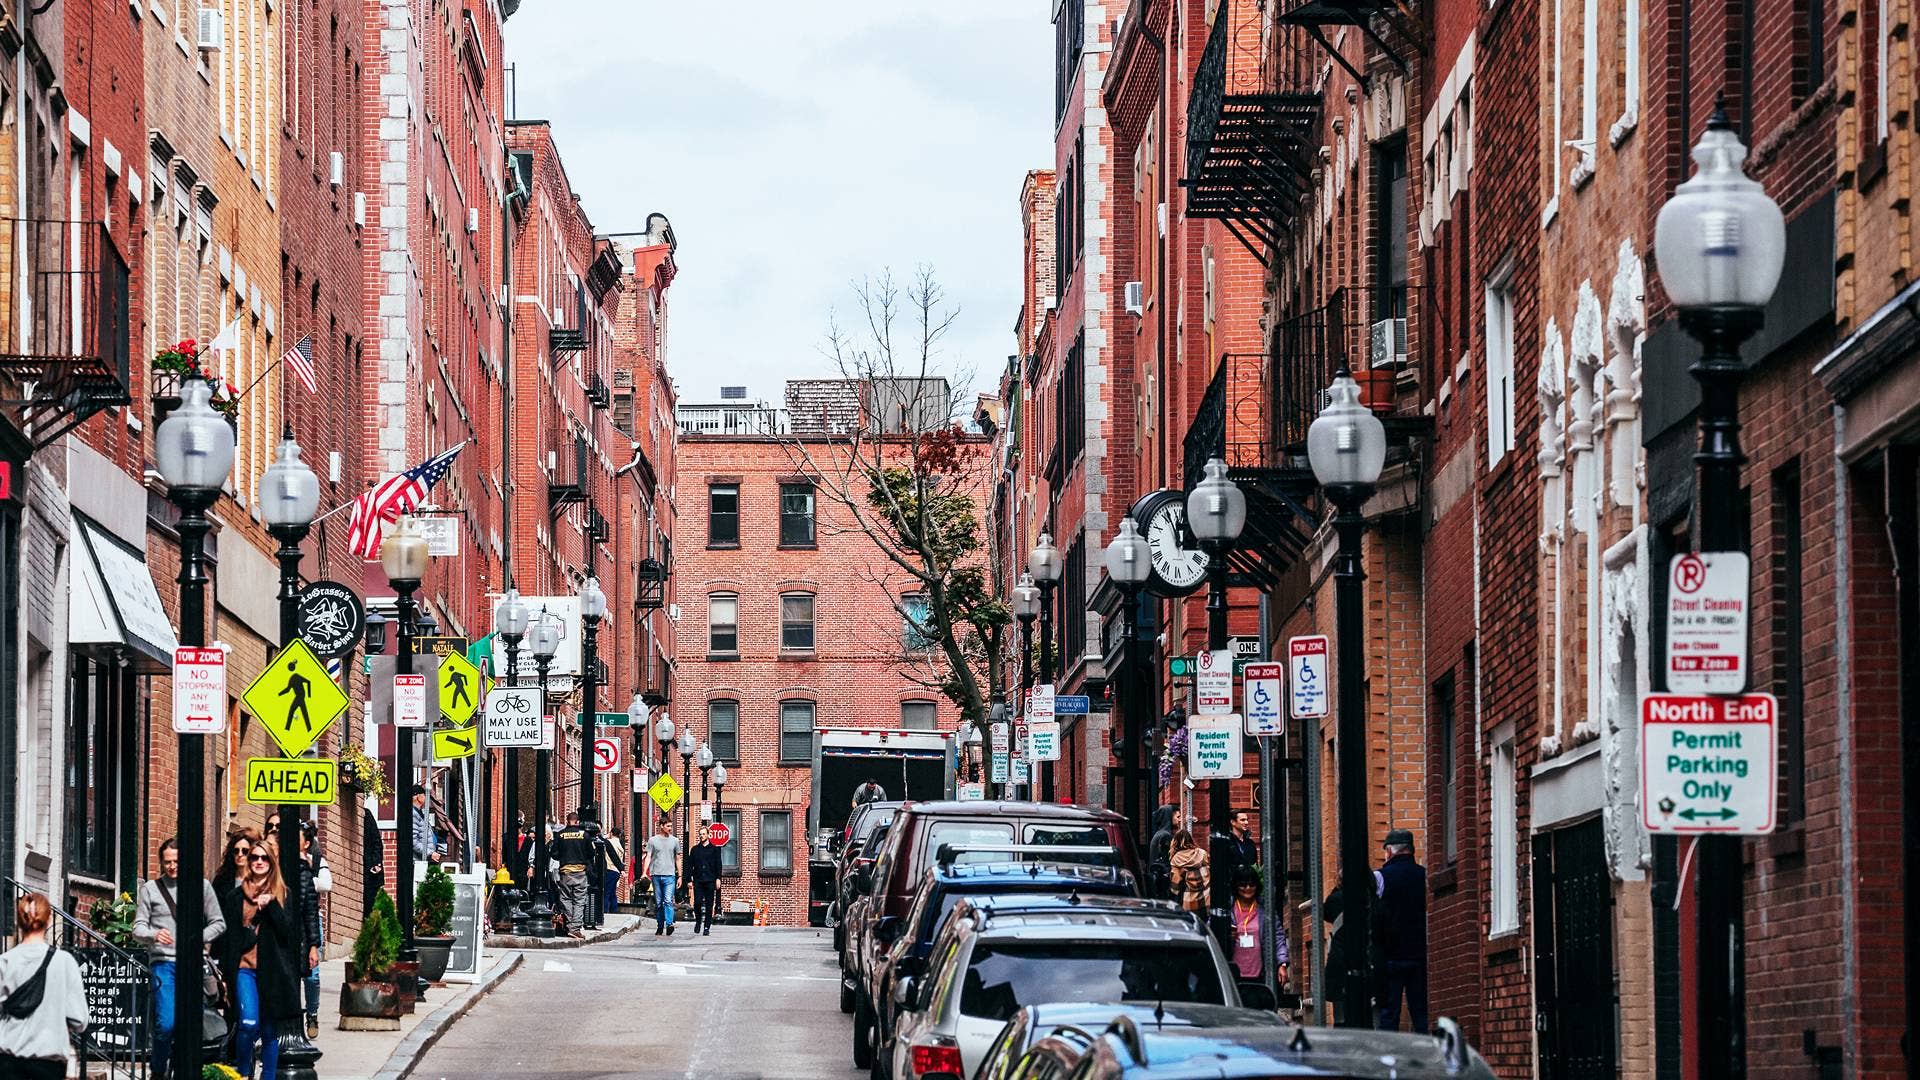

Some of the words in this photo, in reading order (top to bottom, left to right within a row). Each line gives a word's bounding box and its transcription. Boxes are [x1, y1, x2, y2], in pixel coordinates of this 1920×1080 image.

[1673, 599, 1699, 610] Street
[1704, 598, 1742, 612] Cleaning
[333, 631, 354, 649] Shop
[1239, 642, 1257, 652] ONE
[1293, 644, 1306, 652] TOW
[1308, 642, 1324, 650] ZONE
[177, 652, 196, 662] TOW
[198, 652, 222, 662] ZONE
[1676, 656, 1697, 670] Tow
[1702, 657, 1729, 670] Zone
[191, 670, 208, 680] NO
[1262, 668, 1278, 676] ZONE
[178, 682, 222, 690] STOPPING
[190, 704, 209, 712] TIME
[1650, 700, 1714, 721] North
[1724, 700, 1768, 721] End
[490, 718, 512, 726] MAY
[516, 718, 537, 726] USE
[488, 731, 511, 740] FULL
[514, 730, 538, 739] LANE
[1196, 732, 1230, 740] Resident
[1672, 730, 1742, 749] Permit
[1198, 751, 1228, 760] Parking
[1203, 760, 1221, 770] Only
[1667, 754, 1748, 778] Parking
[254, 770, 329, 794] AHEAD
[1683, 780, 1732, 802] Only
[708, 830, 728, 839] STOP
